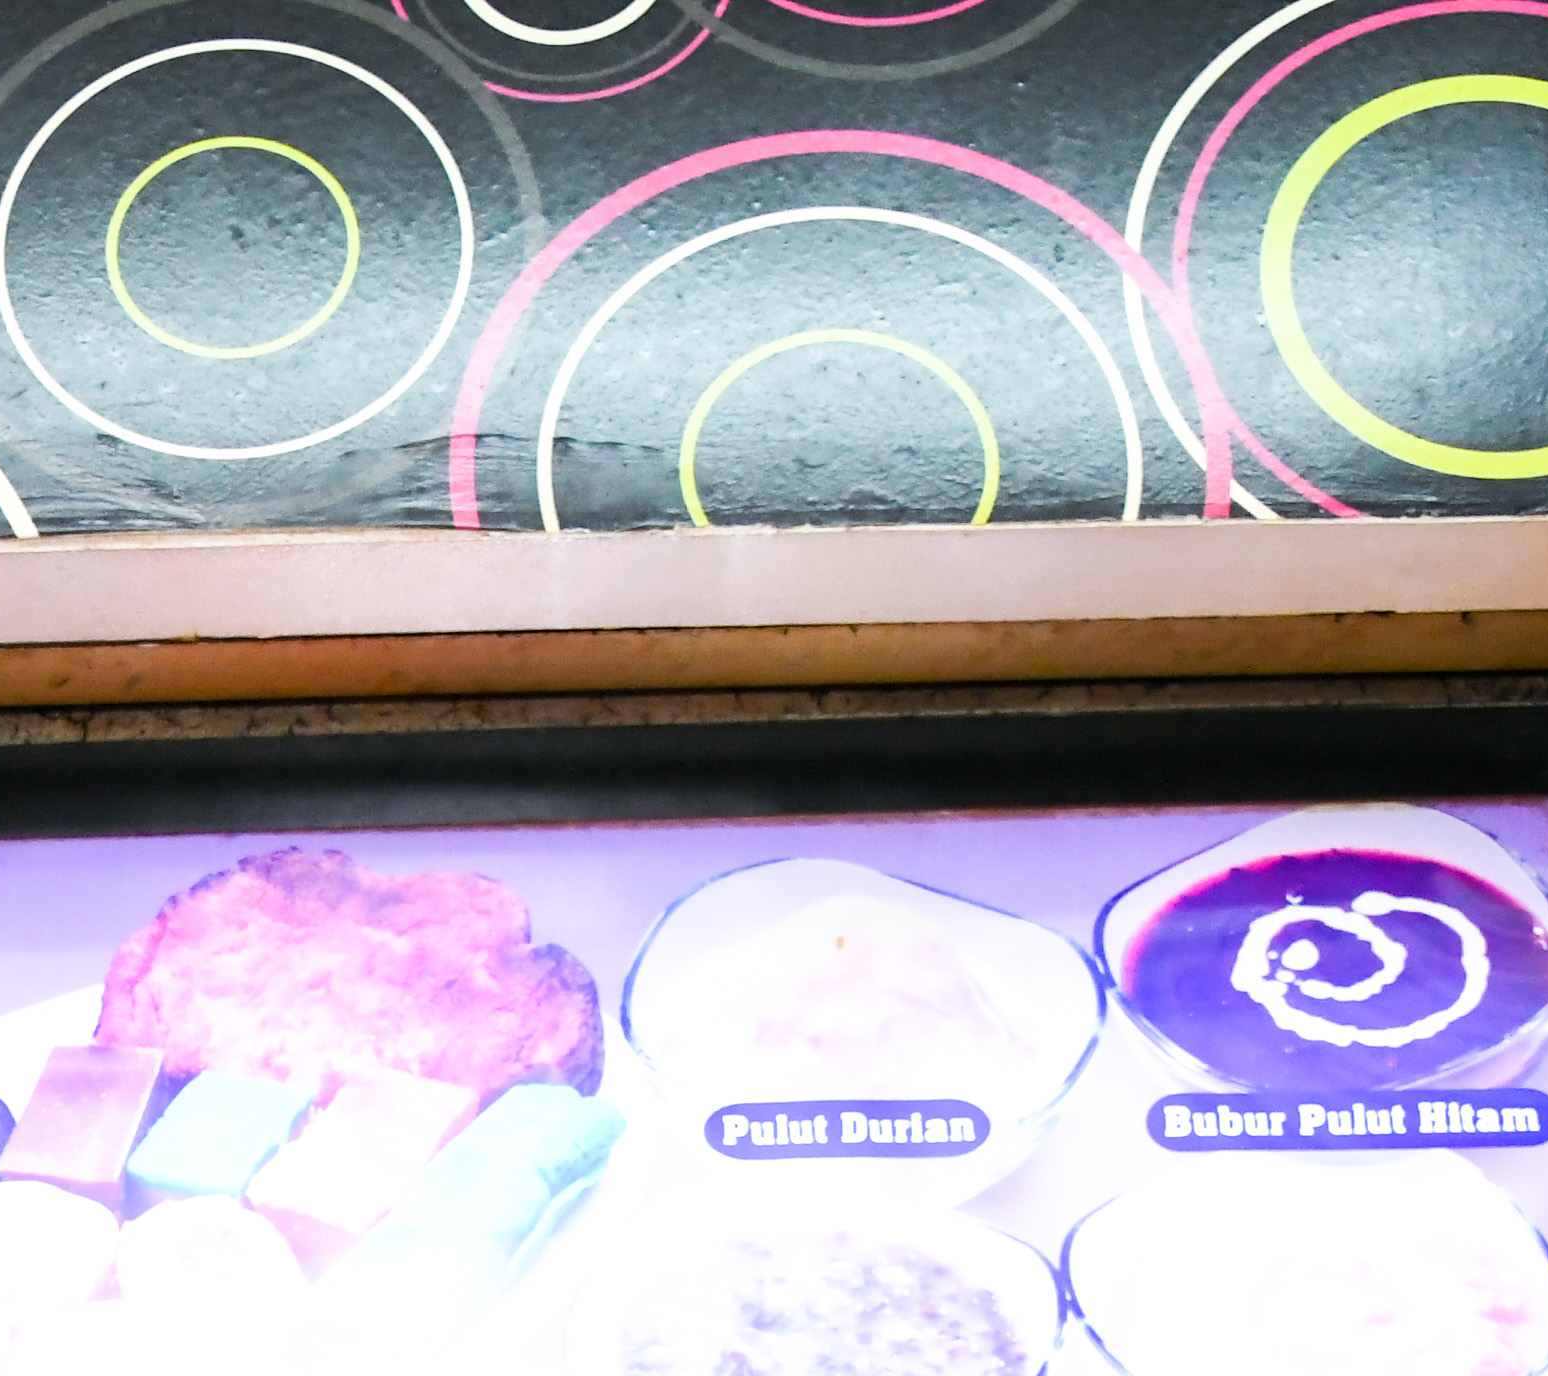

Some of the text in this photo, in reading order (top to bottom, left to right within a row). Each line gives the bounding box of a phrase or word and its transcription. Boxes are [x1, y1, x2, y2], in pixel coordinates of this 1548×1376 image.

[722, 1111, 976, 1146] Pulut Durian
[1163, 1101, 1541, 1137] Bubur Pulut Hitam
